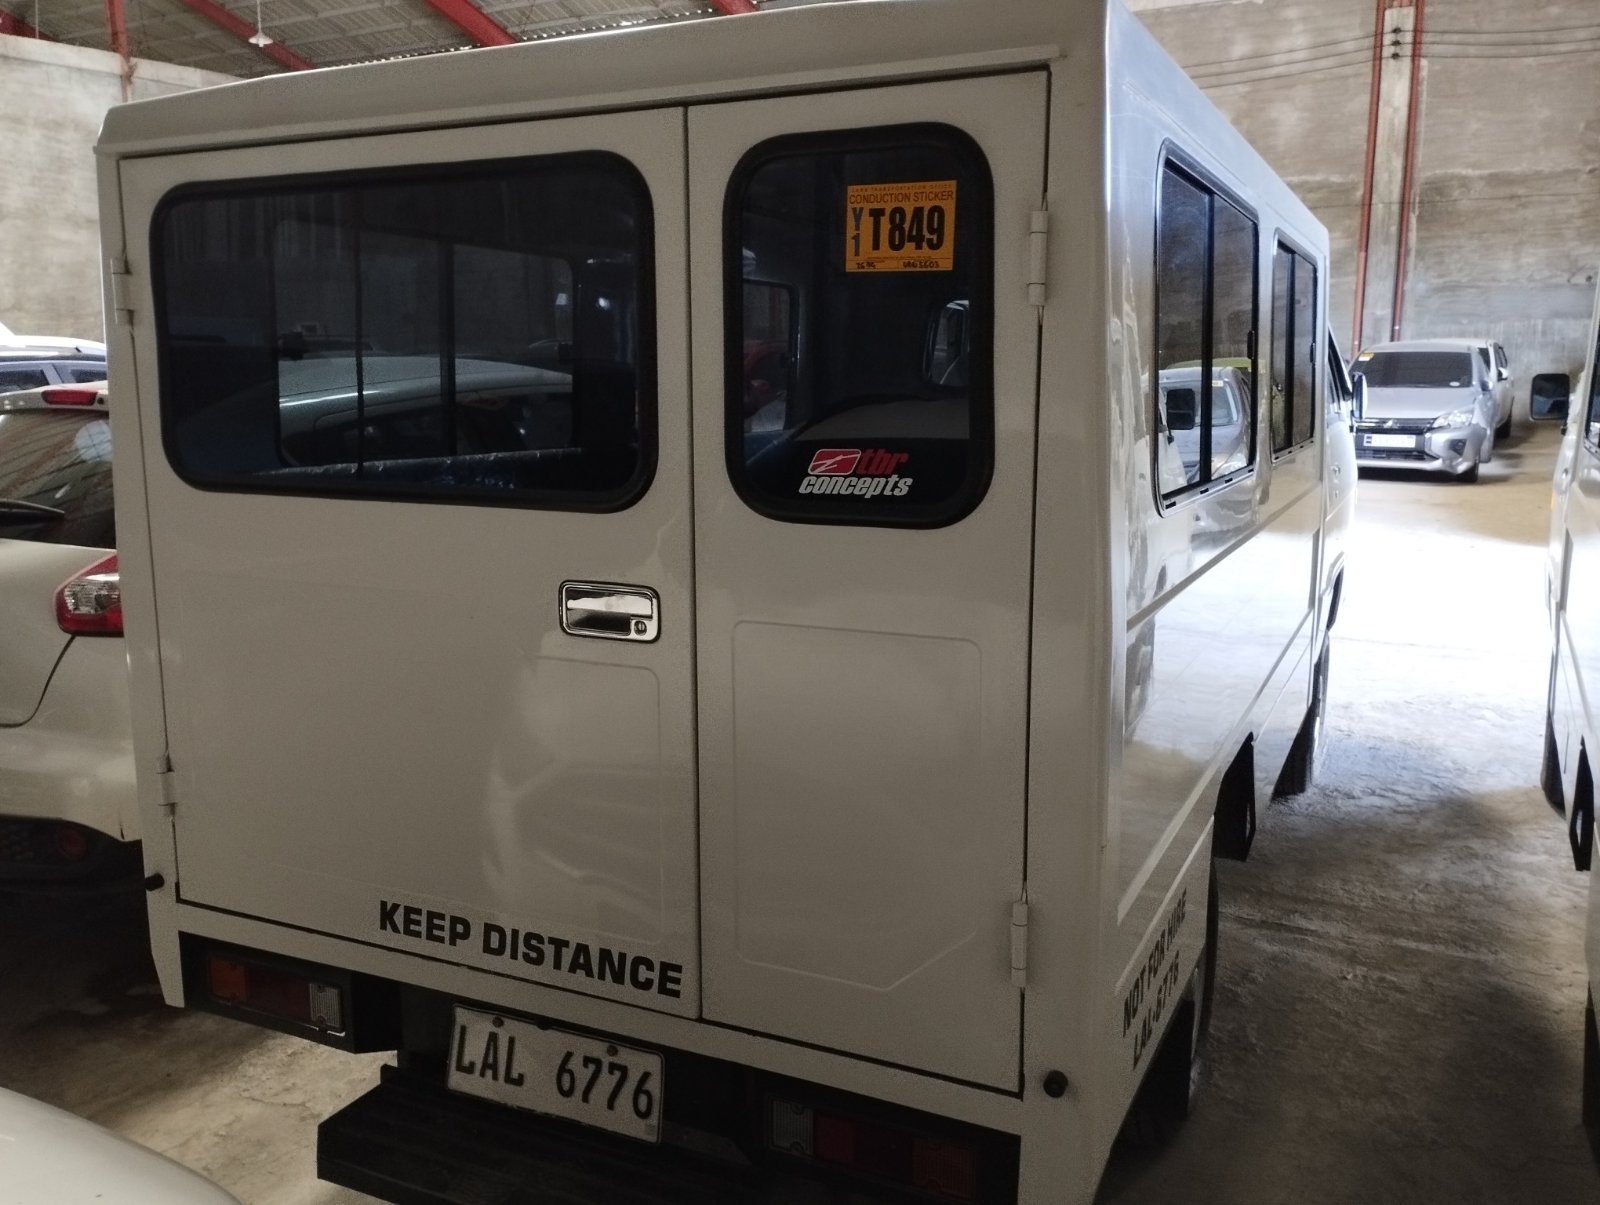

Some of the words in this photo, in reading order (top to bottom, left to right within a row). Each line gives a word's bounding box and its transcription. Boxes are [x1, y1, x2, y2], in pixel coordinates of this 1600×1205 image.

[849, 192, 911, 204] CONDUCTION
[914, 190, 954, 203] STICKER
[868, 205, 945, 251] T849
[856, 448, 910, 475] tbr
[798, 474, 913, 499] concepts
[380, 900, 471, 947] KEEP
[482, 921, 683, 998] DISTANCE
[1123, 964, 1146, 1038] NOT
[1147, 928, 1166, 990] FOR
[1167, 887, 1187, 951] HIRE
[455, 1024, 525, 1087] LAL
[556, 1050, 654, 1120] 6776
